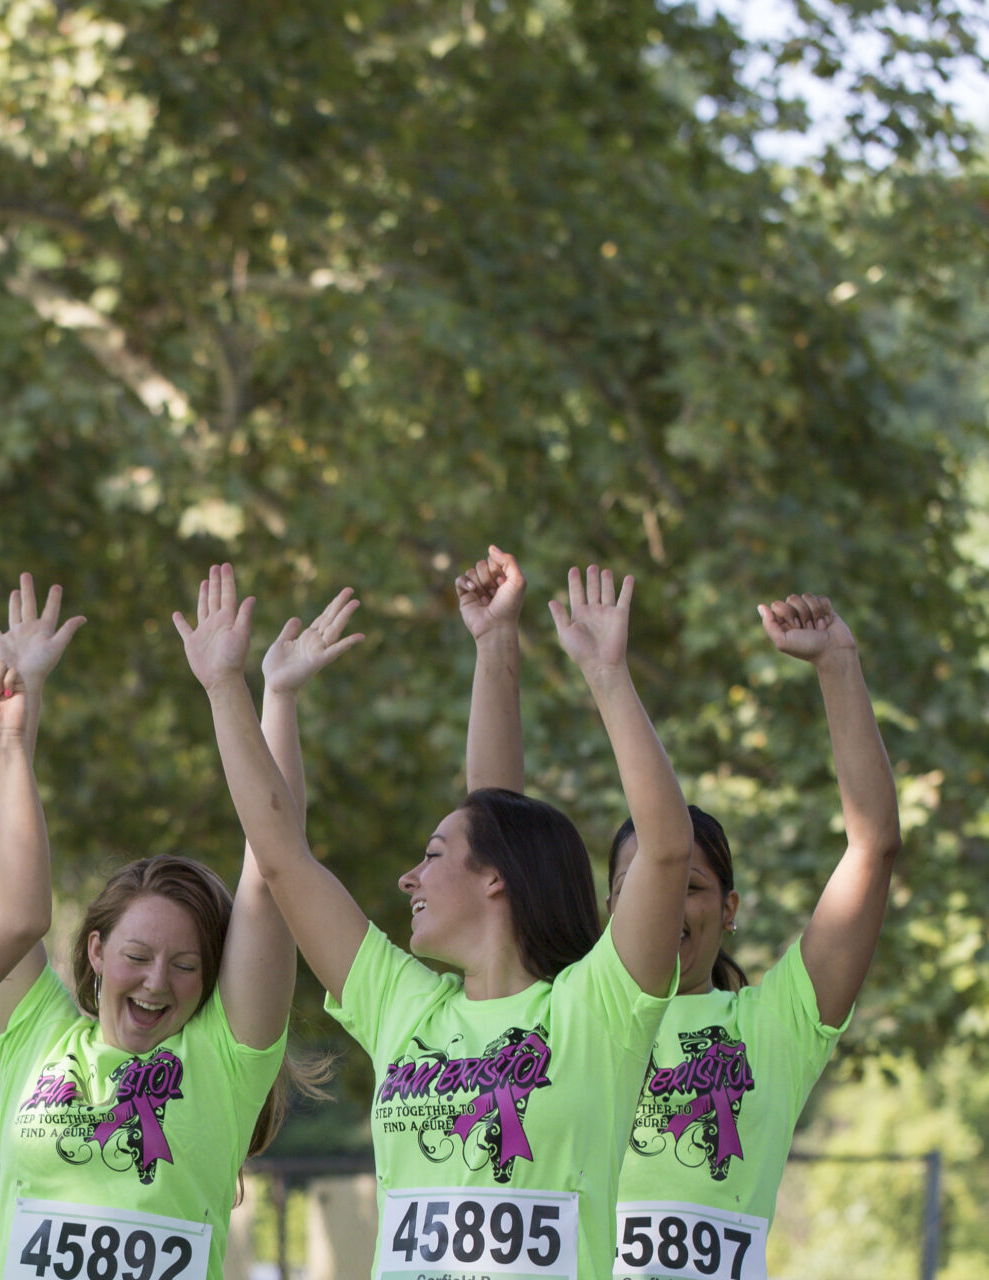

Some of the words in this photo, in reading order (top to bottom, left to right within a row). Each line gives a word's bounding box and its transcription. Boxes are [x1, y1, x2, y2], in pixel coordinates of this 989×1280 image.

[435, 1047, 552, 1095] BRISTOL
[649, 1055, 755, 1096] BRISTOL
[117, 1059, 183, 1101] STOL
[376, 1106, 393, 1119] STEP
[396, 1104, 456, 1117] TOGETHER
[460, 1103, 476, 1115] TO
[636, 1104, 671, 1114] THER
[676, 1104, 692, 1115] TO
[39, 1113, 100, 1124] TOGETHER
[101, 1113, 115, 1123] TO
[384, 1121, 406, 1133] FIND
[410, 1121, 418, 1131] A
[422, 1120, 453, 1131] CURE
[636, 1118, 668, 1127] CURE
[20, 1127, 46, 1138] FIND
[50, 1128, 59, 1138] A
[63, 1127, 94, 1137] CURE
[392, 1201, 561, 1266] 45895
[615, 1216, 751, 1280] 5897
